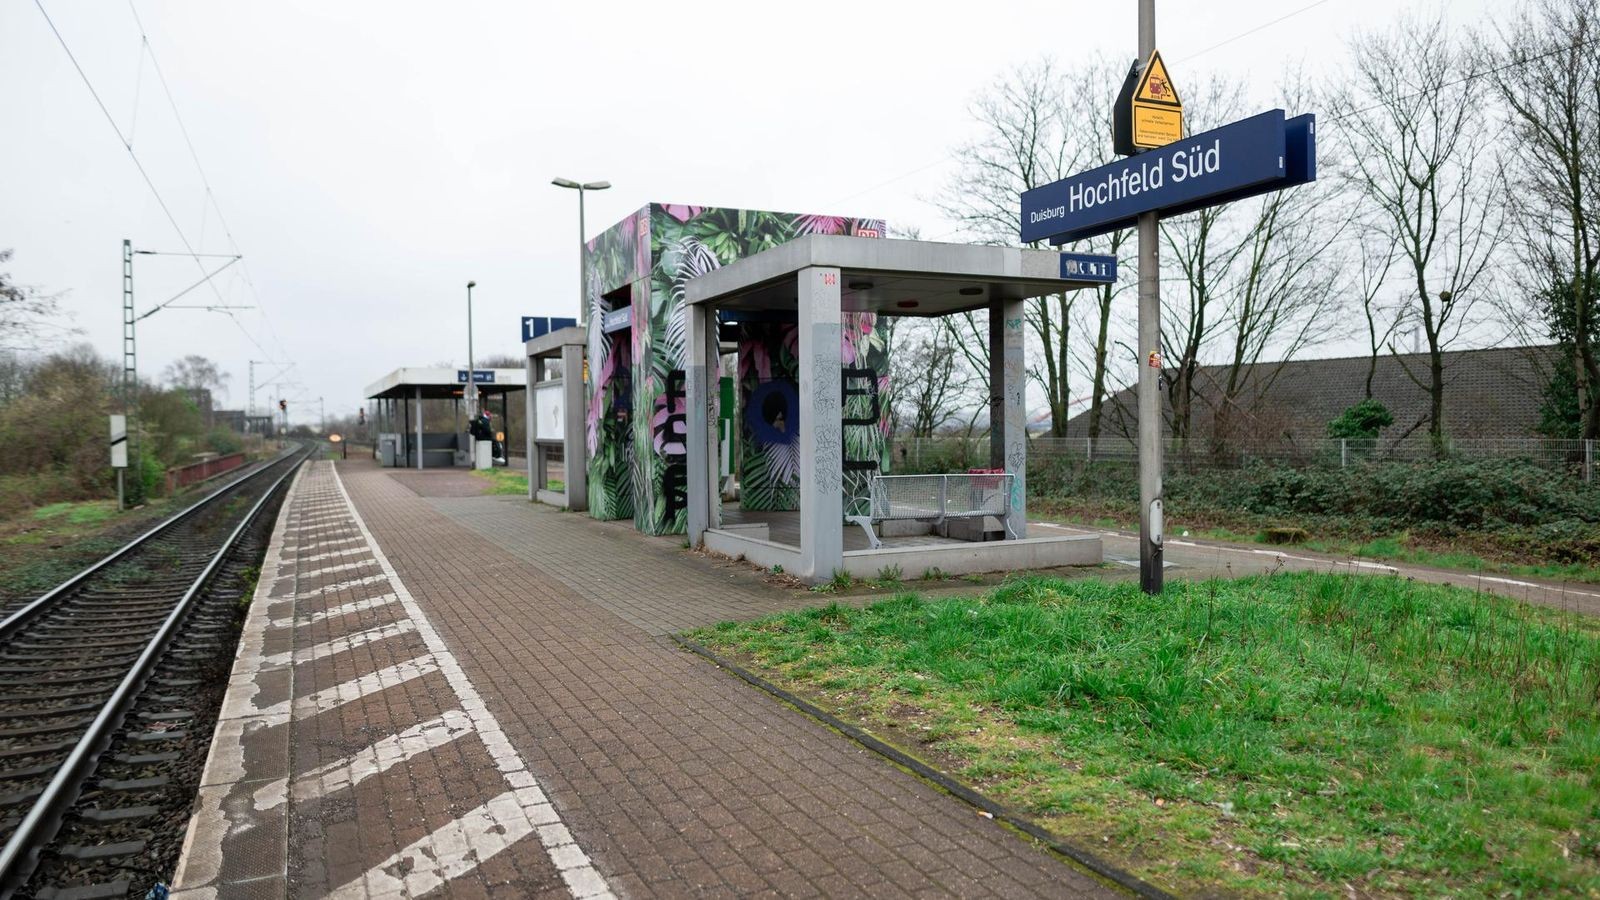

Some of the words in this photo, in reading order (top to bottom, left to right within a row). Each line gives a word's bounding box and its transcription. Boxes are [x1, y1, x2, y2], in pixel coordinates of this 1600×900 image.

[1030, 205, 1065, 224] Duisburg
[1069, 157, 1163, 213] Hochfeld
[1171, 139, 1220, 183] Süd
[525, 318, 534, 338] 1
